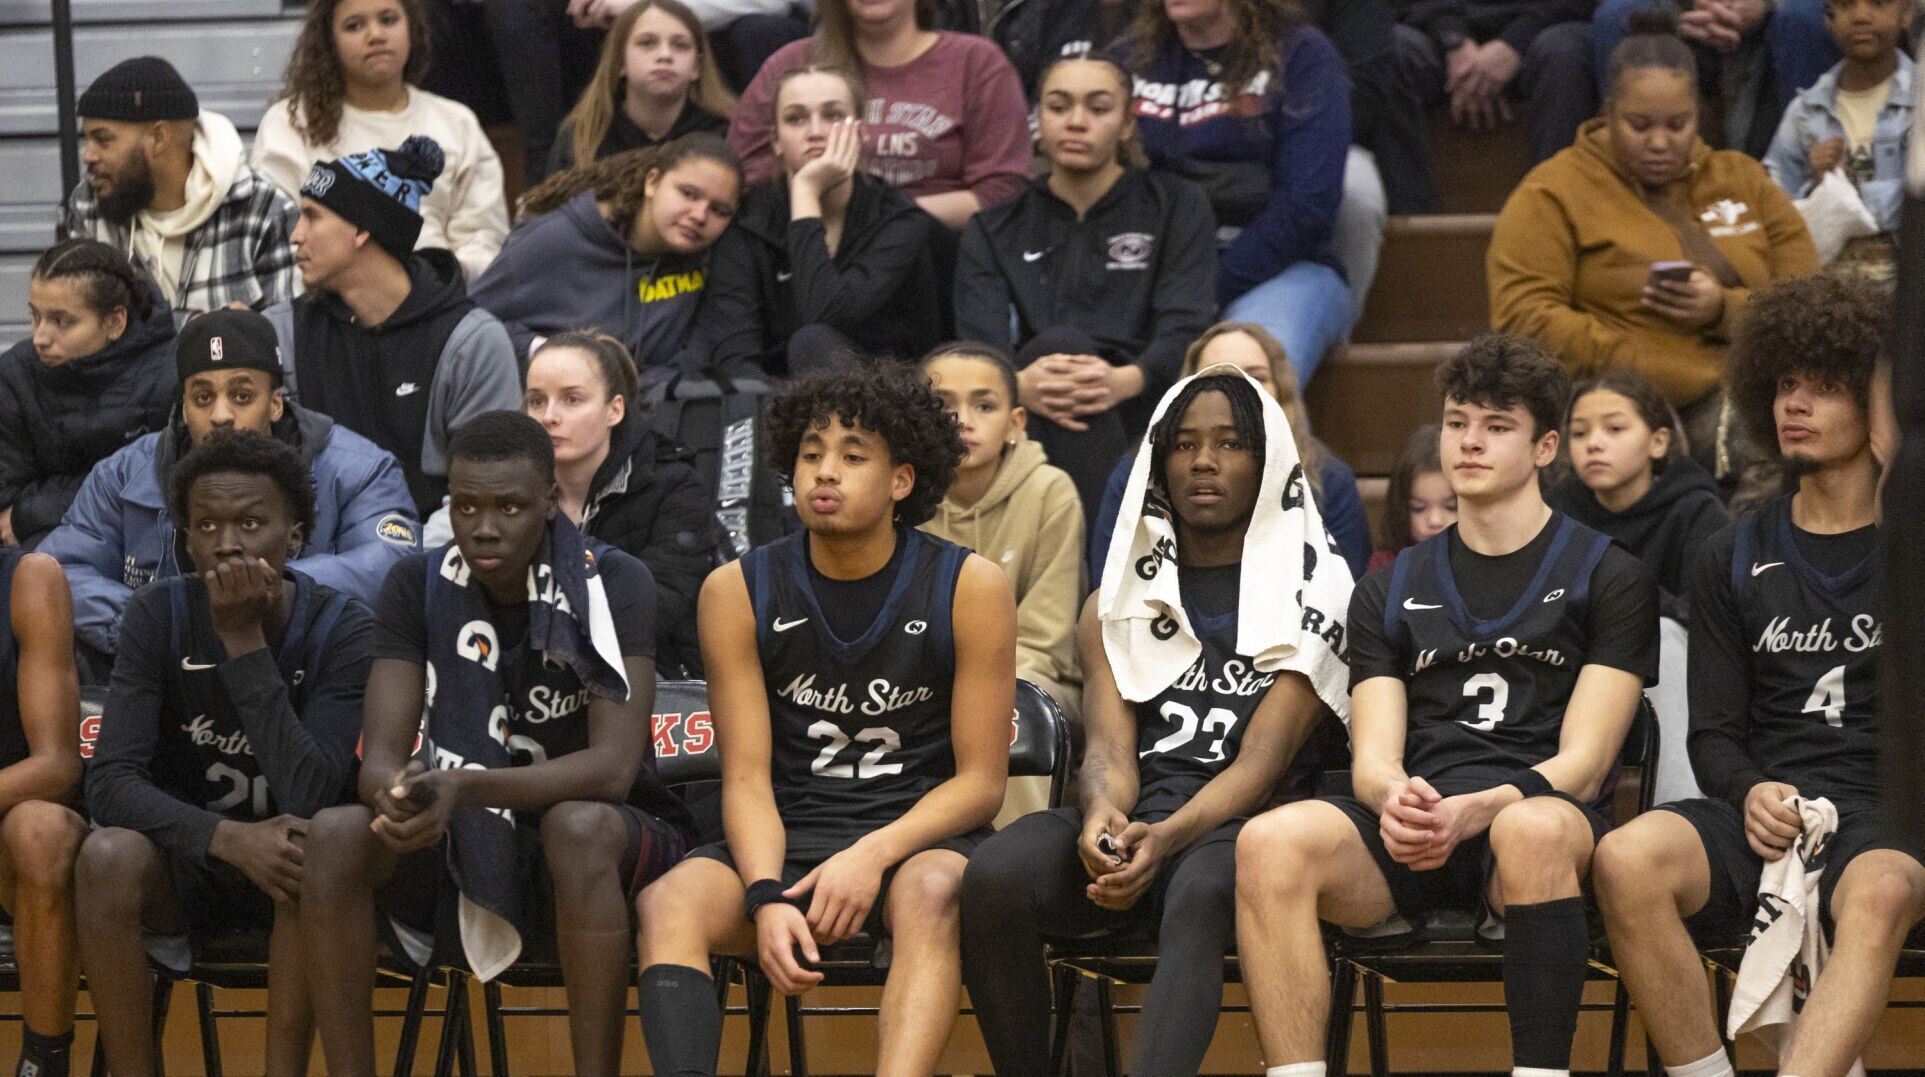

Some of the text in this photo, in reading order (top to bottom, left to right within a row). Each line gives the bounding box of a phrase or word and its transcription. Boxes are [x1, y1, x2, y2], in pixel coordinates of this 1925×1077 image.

[1752, 616, 1838, 653] North
[524, 685, 590, 724] Star
[777, 673, 934, 716] North Star
[1455, 672, 1509, 732] 3
[1801, 665, 1847, 728] 4
[178, 714, 254, 756] North
[651, 710, 714, 757] KS
[807, 719, 904, 779] 22
[1139, 700, 1238, 764] 23
